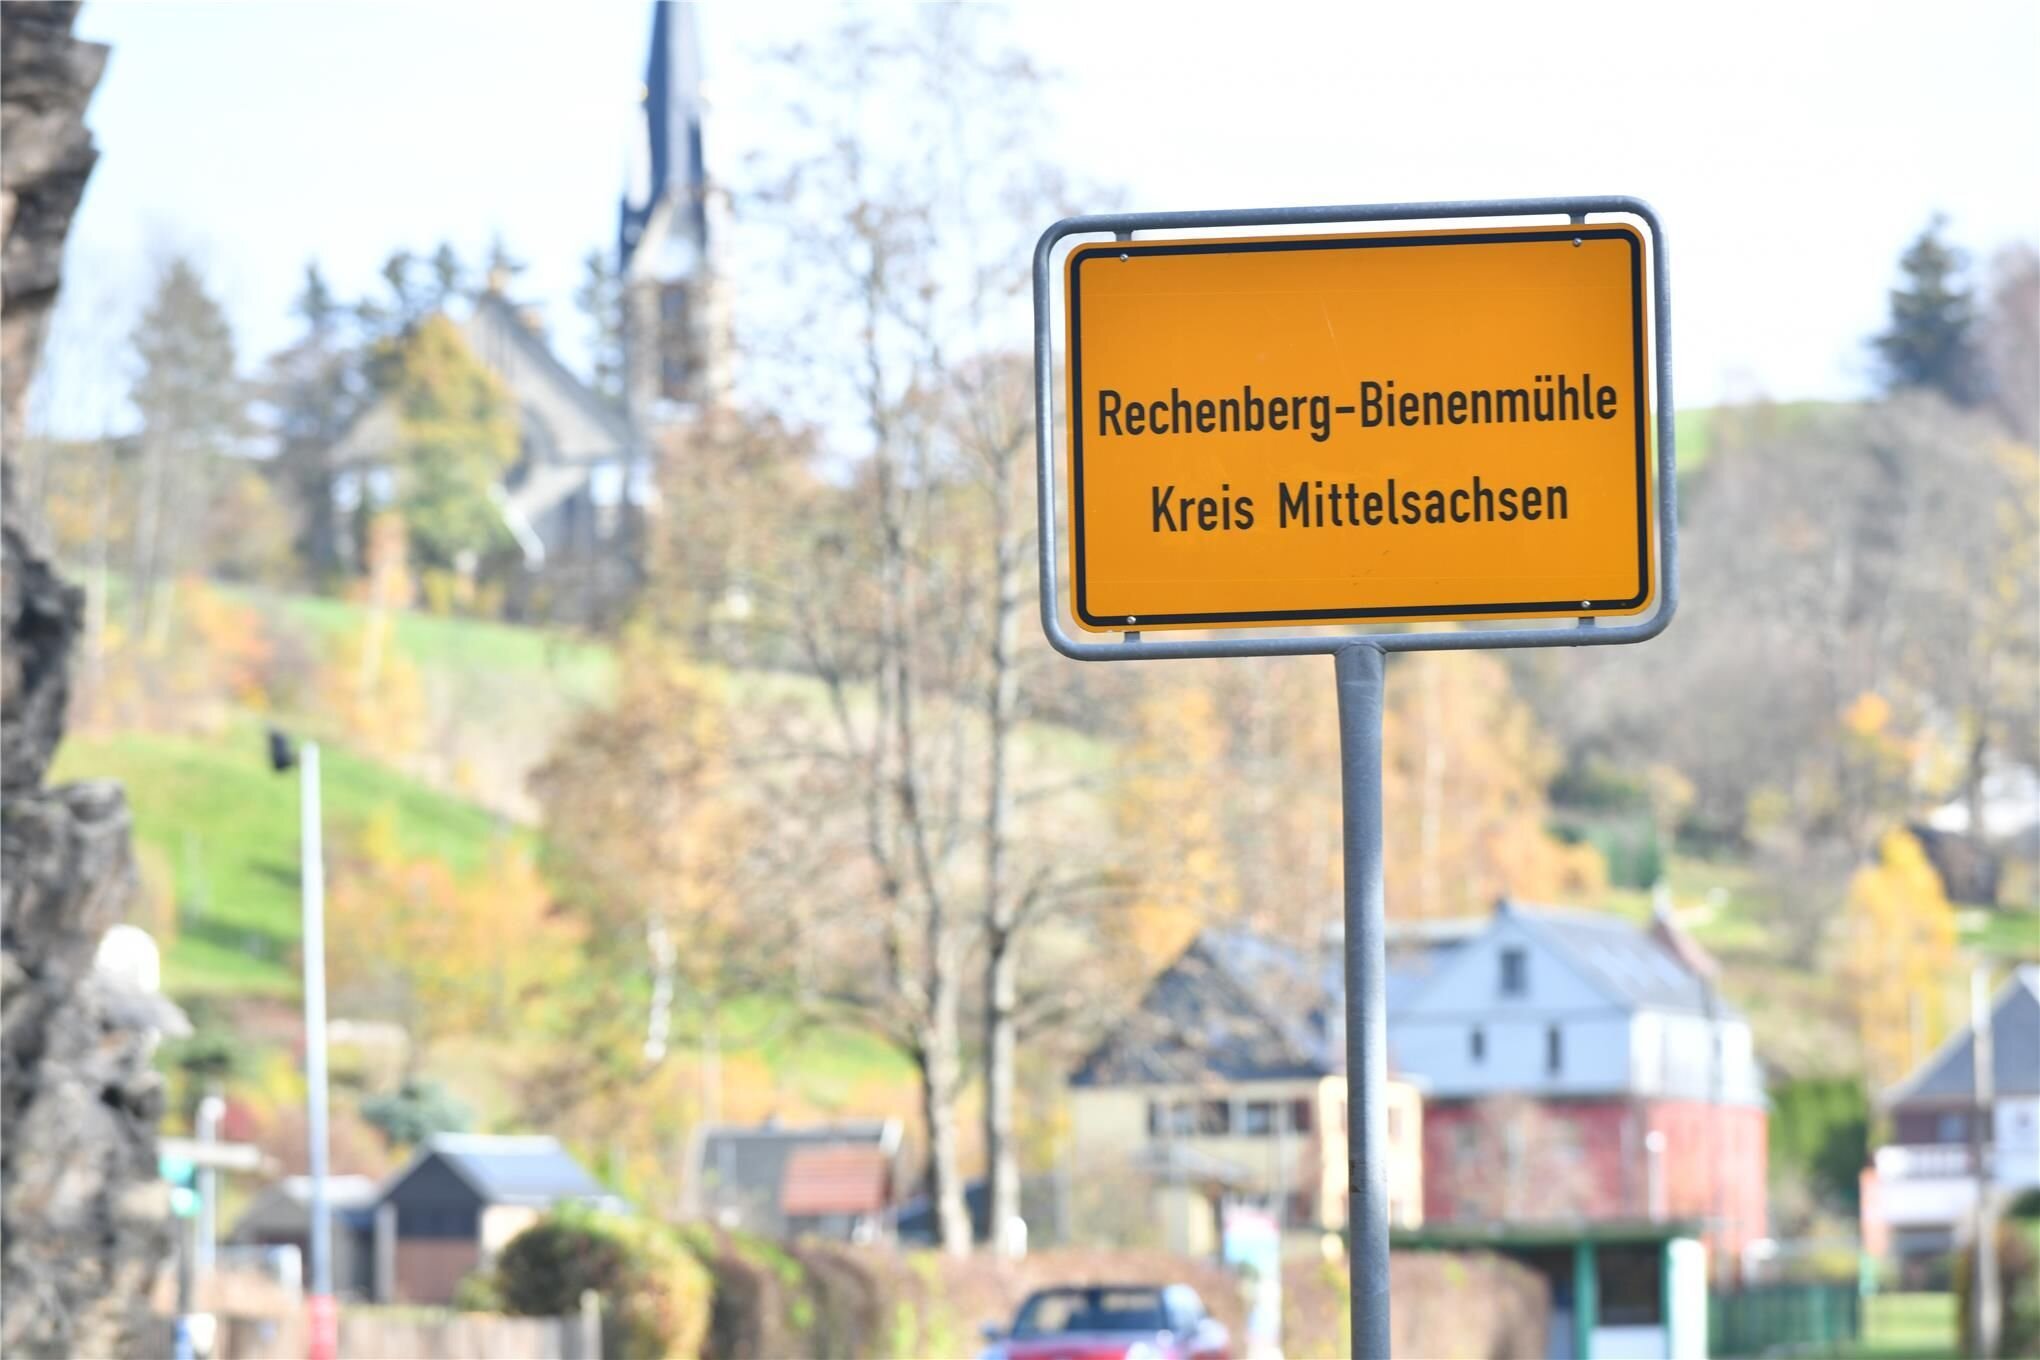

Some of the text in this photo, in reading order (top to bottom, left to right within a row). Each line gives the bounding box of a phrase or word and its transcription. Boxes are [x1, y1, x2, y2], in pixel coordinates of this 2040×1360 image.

[1099, 373, 1618, 443] Rechenberg-Bienenmühle
[1152, 476, 1568, 532] Kreis Mittelsachsen
